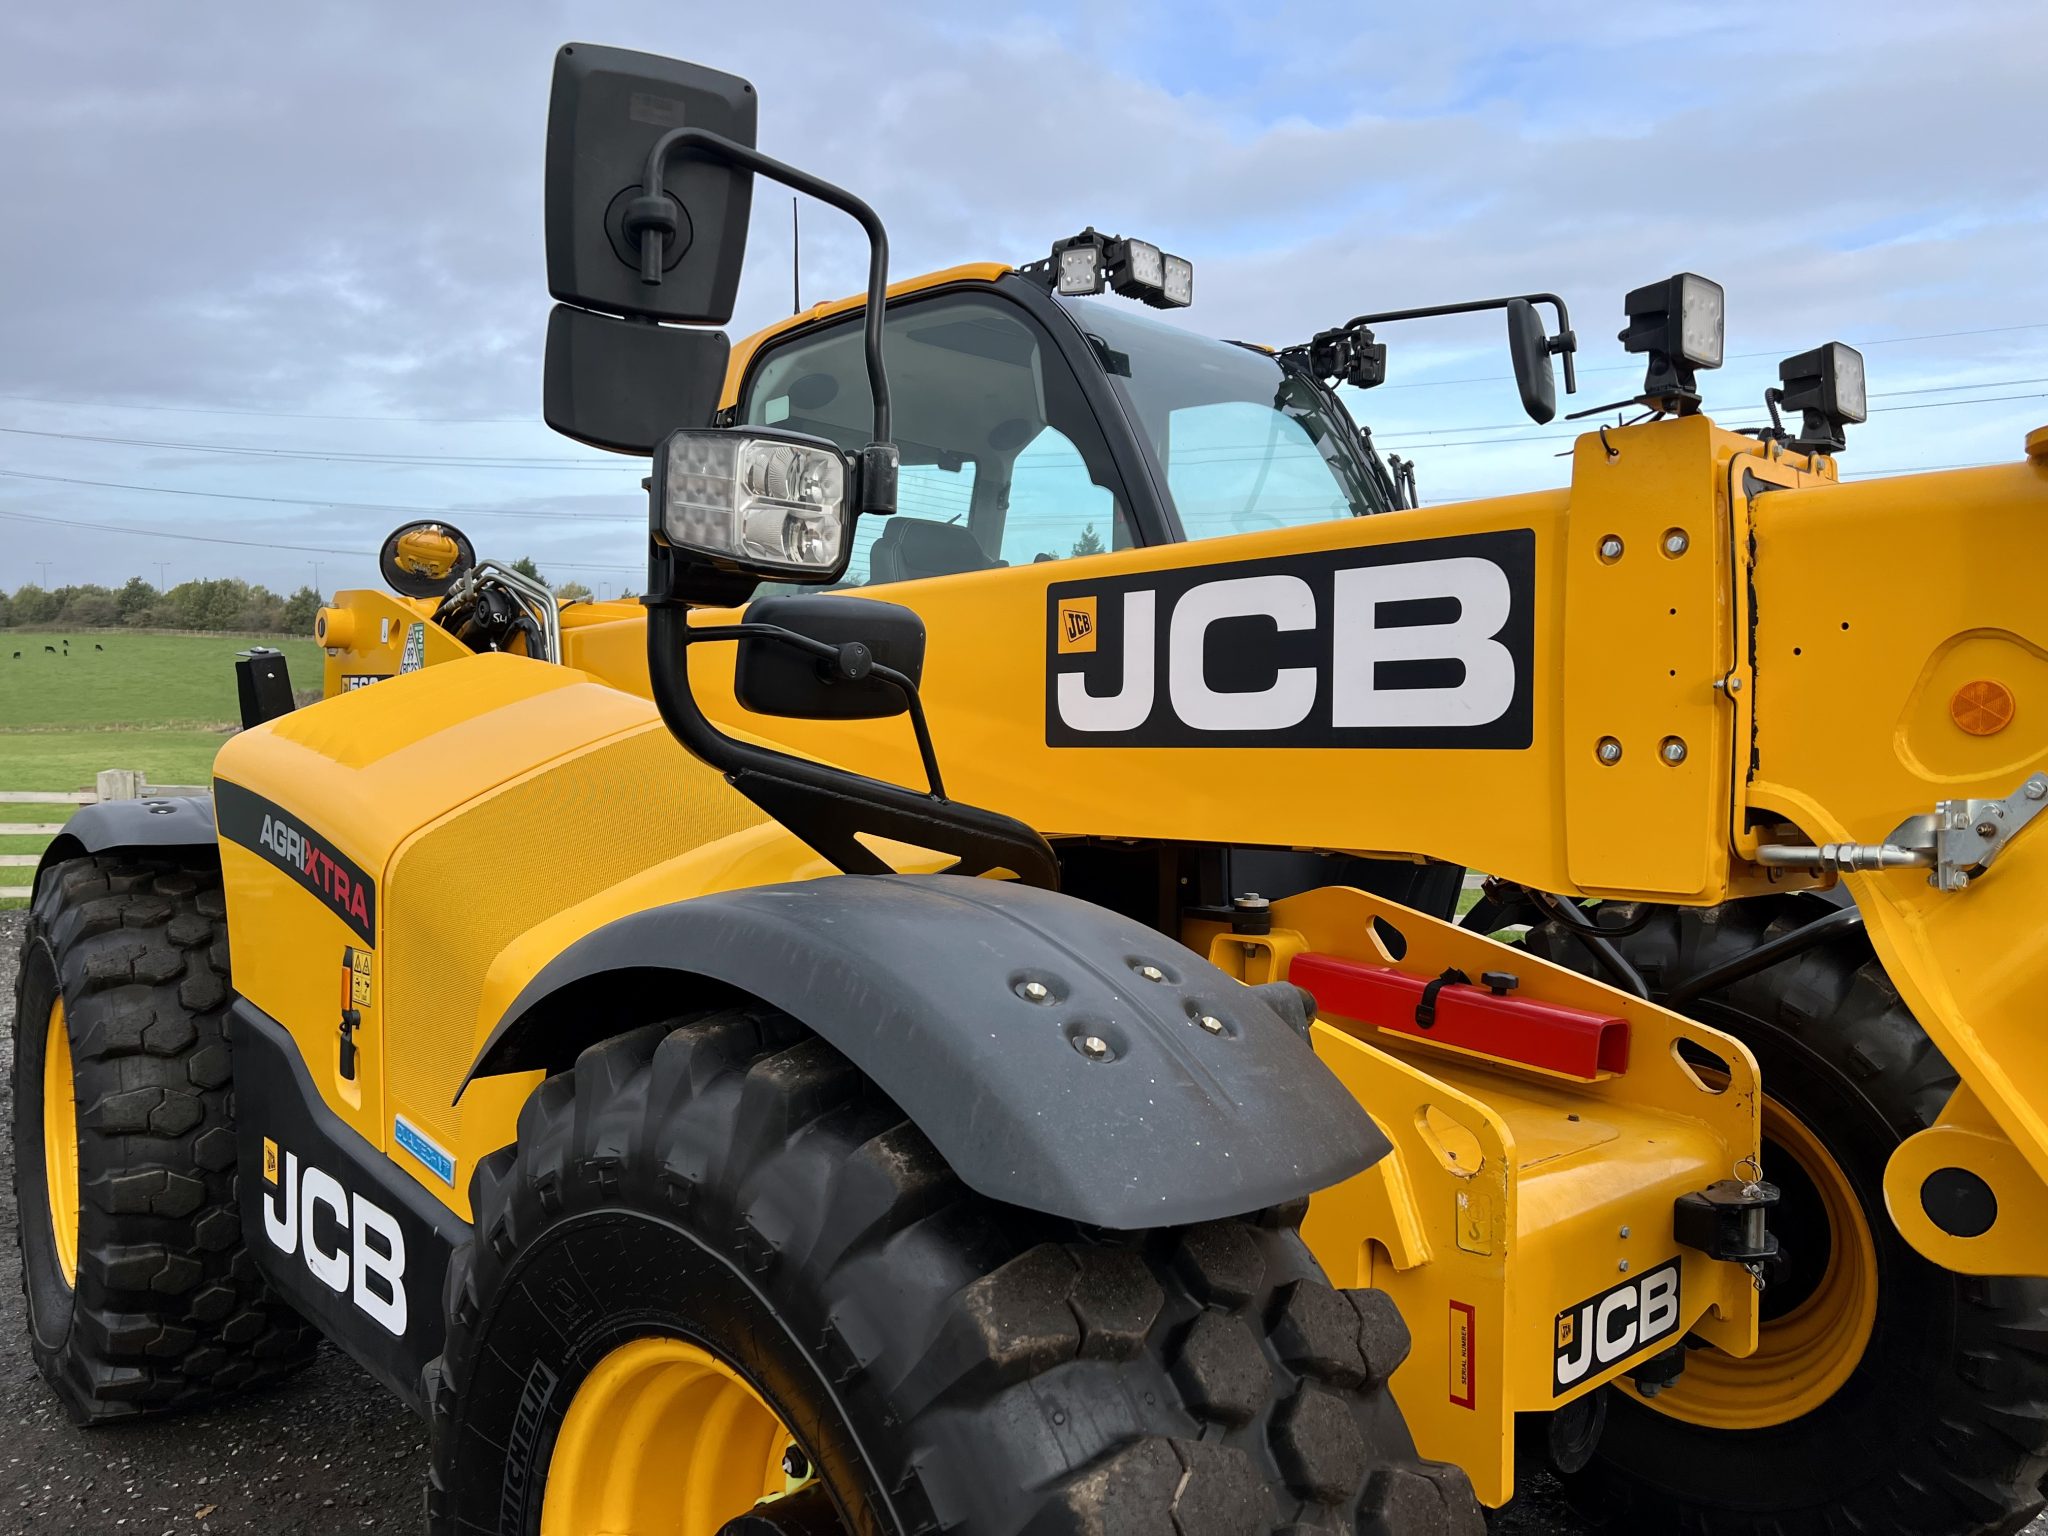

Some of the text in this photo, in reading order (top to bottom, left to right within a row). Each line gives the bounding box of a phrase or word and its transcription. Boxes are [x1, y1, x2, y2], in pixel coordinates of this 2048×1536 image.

[1058, 557, 1516, 732] JCB
[1068, 613, 1090, 638] JCB
[264, 1151, 408, 1336] JCB
[1557, 1266, 1678, 1385] JCB
